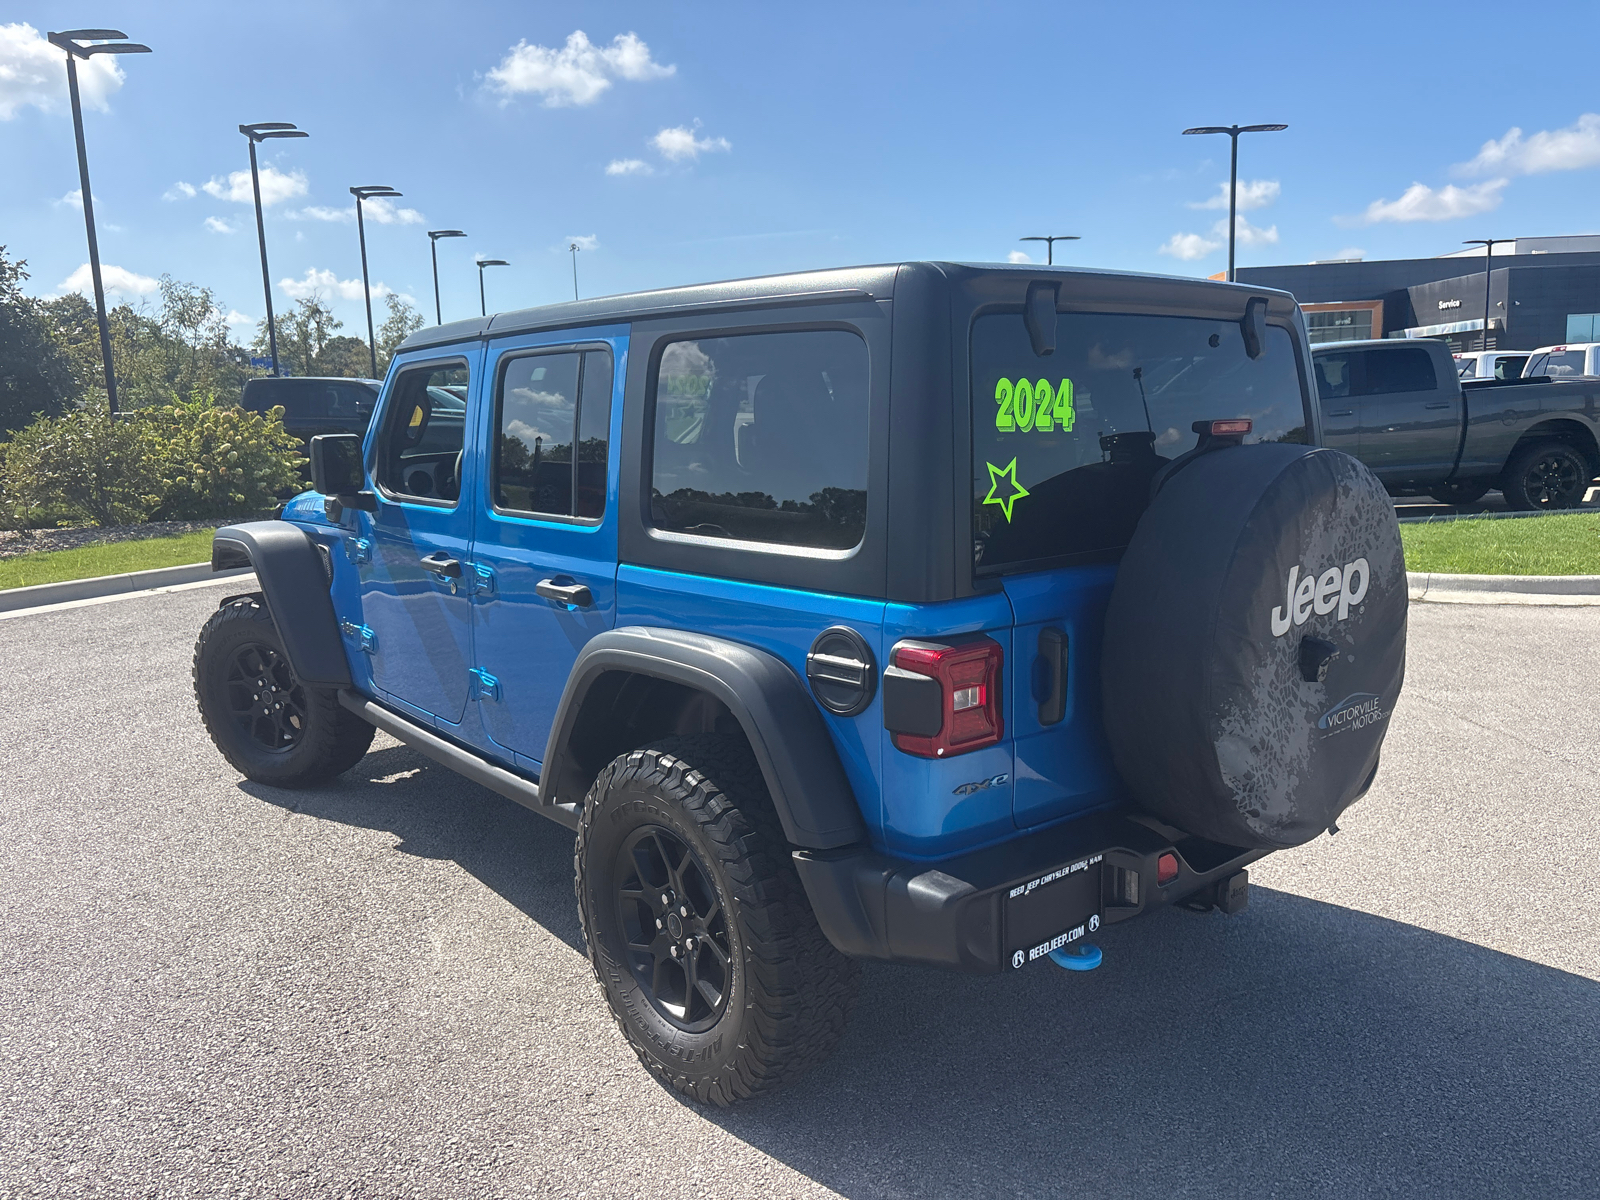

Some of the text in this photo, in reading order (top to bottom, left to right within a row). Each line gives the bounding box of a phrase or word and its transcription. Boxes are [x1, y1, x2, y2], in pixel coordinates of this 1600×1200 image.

[1438, 299, 1461, 310] Service
[995, 378, 1075, 432] 2024
[1271, 557, 1370, 637] Jeep
[1327, 697, 1379, 727] VICTORVILLE
[1009, 885, 1025, 899] REED
[1026, 879, 1040, 891] JEEP
[1041, 866, 1069, 885] CHRYSLER
[1089, 854, 1103, 865] RAM
[1029, 924, 1085, 962] REEDJEEP.COM
